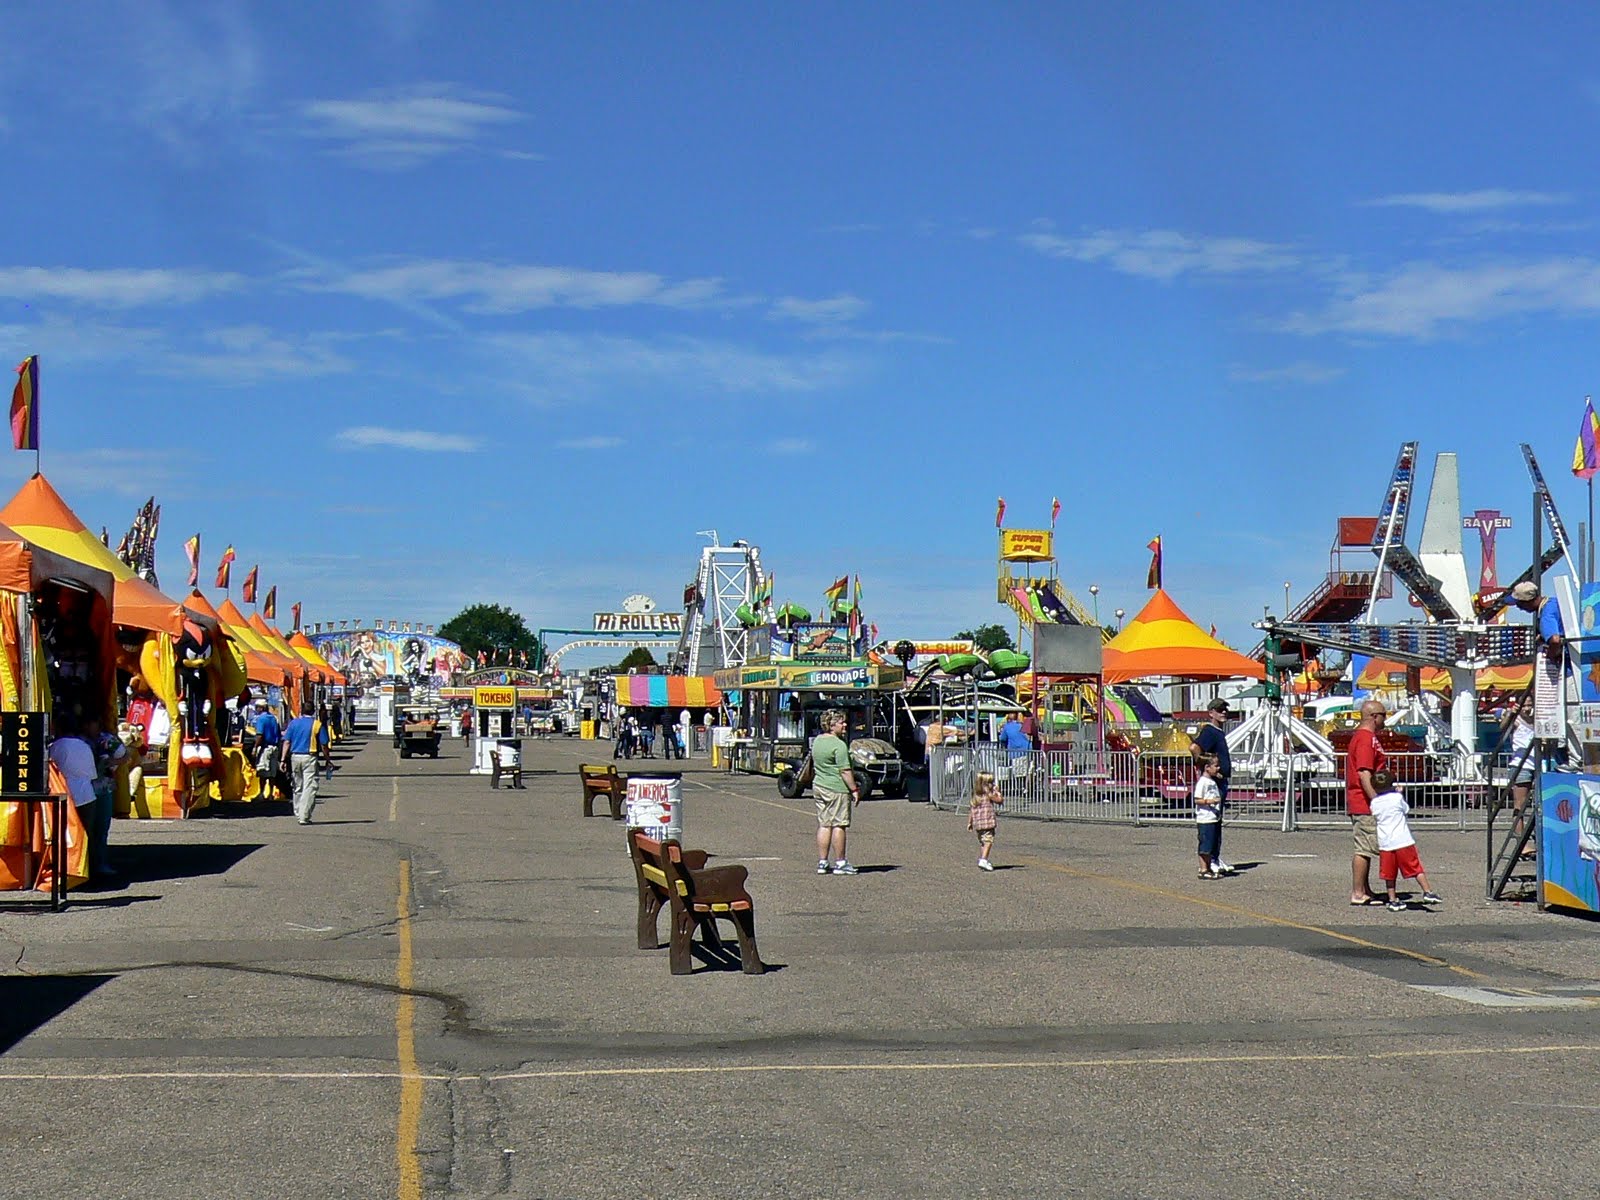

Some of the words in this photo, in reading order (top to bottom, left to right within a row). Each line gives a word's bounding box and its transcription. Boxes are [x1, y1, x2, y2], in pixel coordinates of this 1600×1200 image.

[1463, 518, 1511, 536] RAVEN
[1011, 534, 1043, 543] SUPER
[619, 614, 680, 630] ROLLER
[810, 668, 866, 685] LEMONADE
[480, 693, 511, 704] TOKENS
[18, 714, 29, 791] TOKENS
